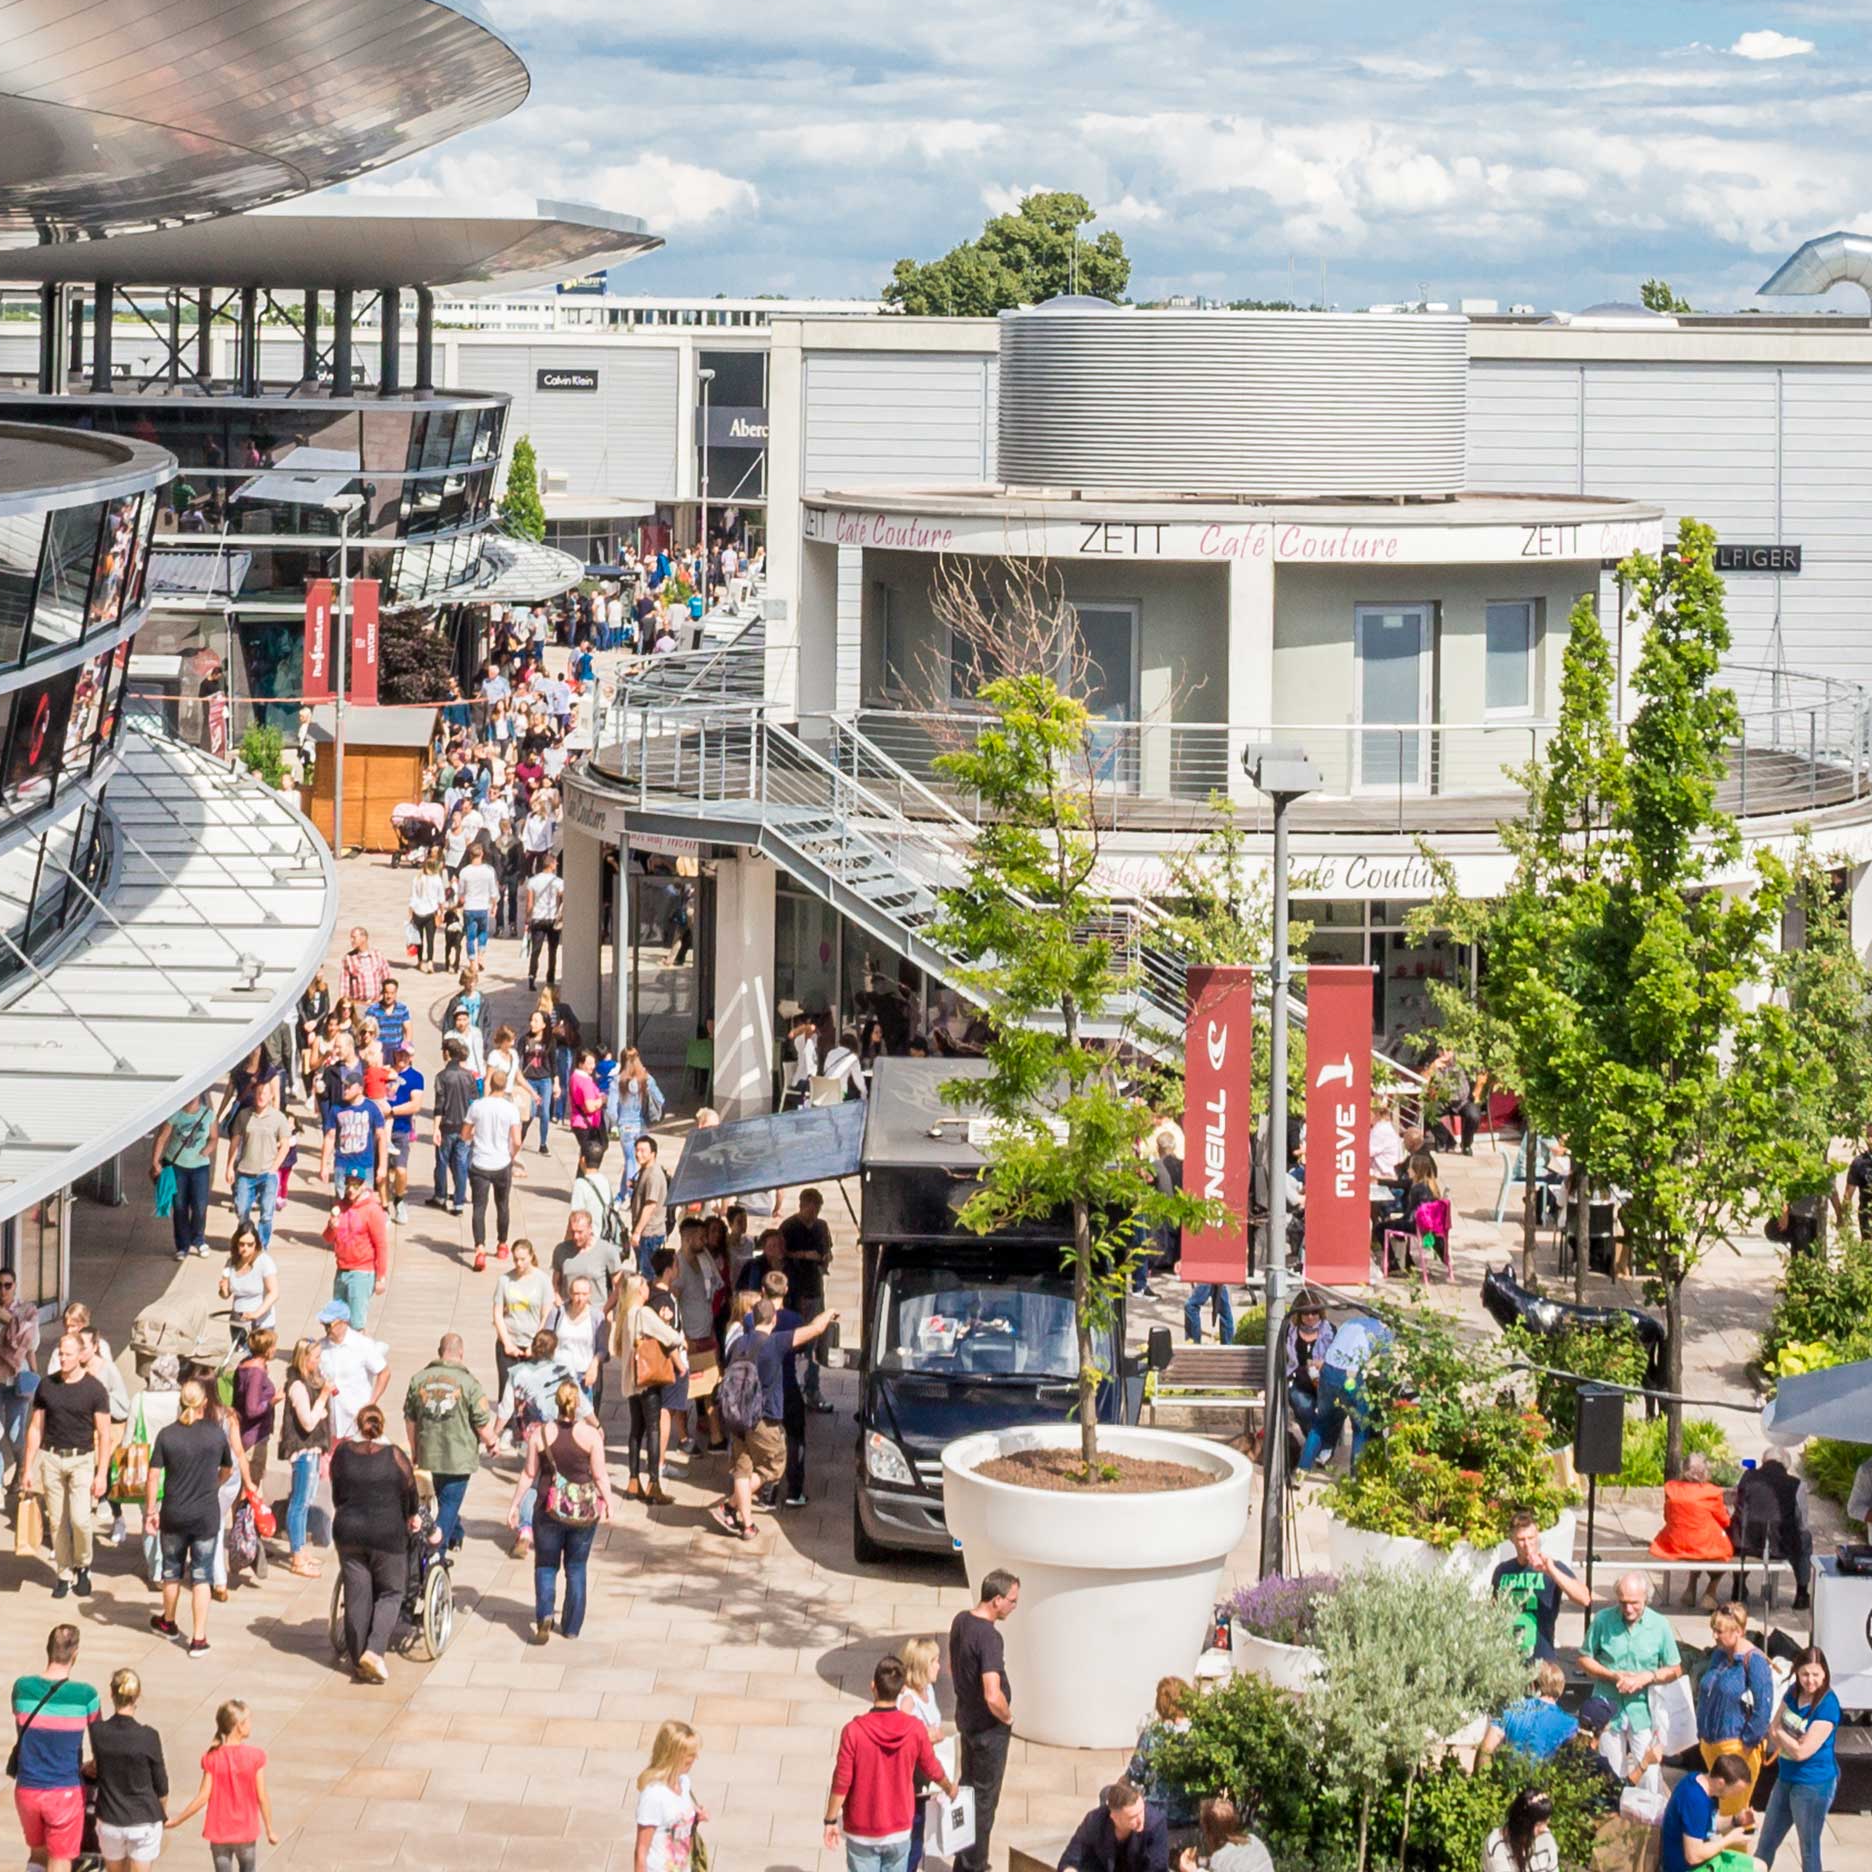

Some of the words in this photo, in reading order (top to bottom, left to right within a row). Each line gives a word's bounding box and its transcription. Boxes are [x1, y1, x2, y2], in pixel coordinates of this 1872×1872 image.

[543, 374, 571, 386] Calvin
[572, 375, 594, 386] Klein
[835, 511, 867, 544] Café
[872, 514, 954, 549] Couture
[1079, 522, 1170, 554] ZETT
[1199, 523, 1265, 559] Café
[1279, 523, 1399, 558] Couture
[1521, 523, 1581, 557] ZETT
[1710, 548, 1797, 568] ILFIGER
